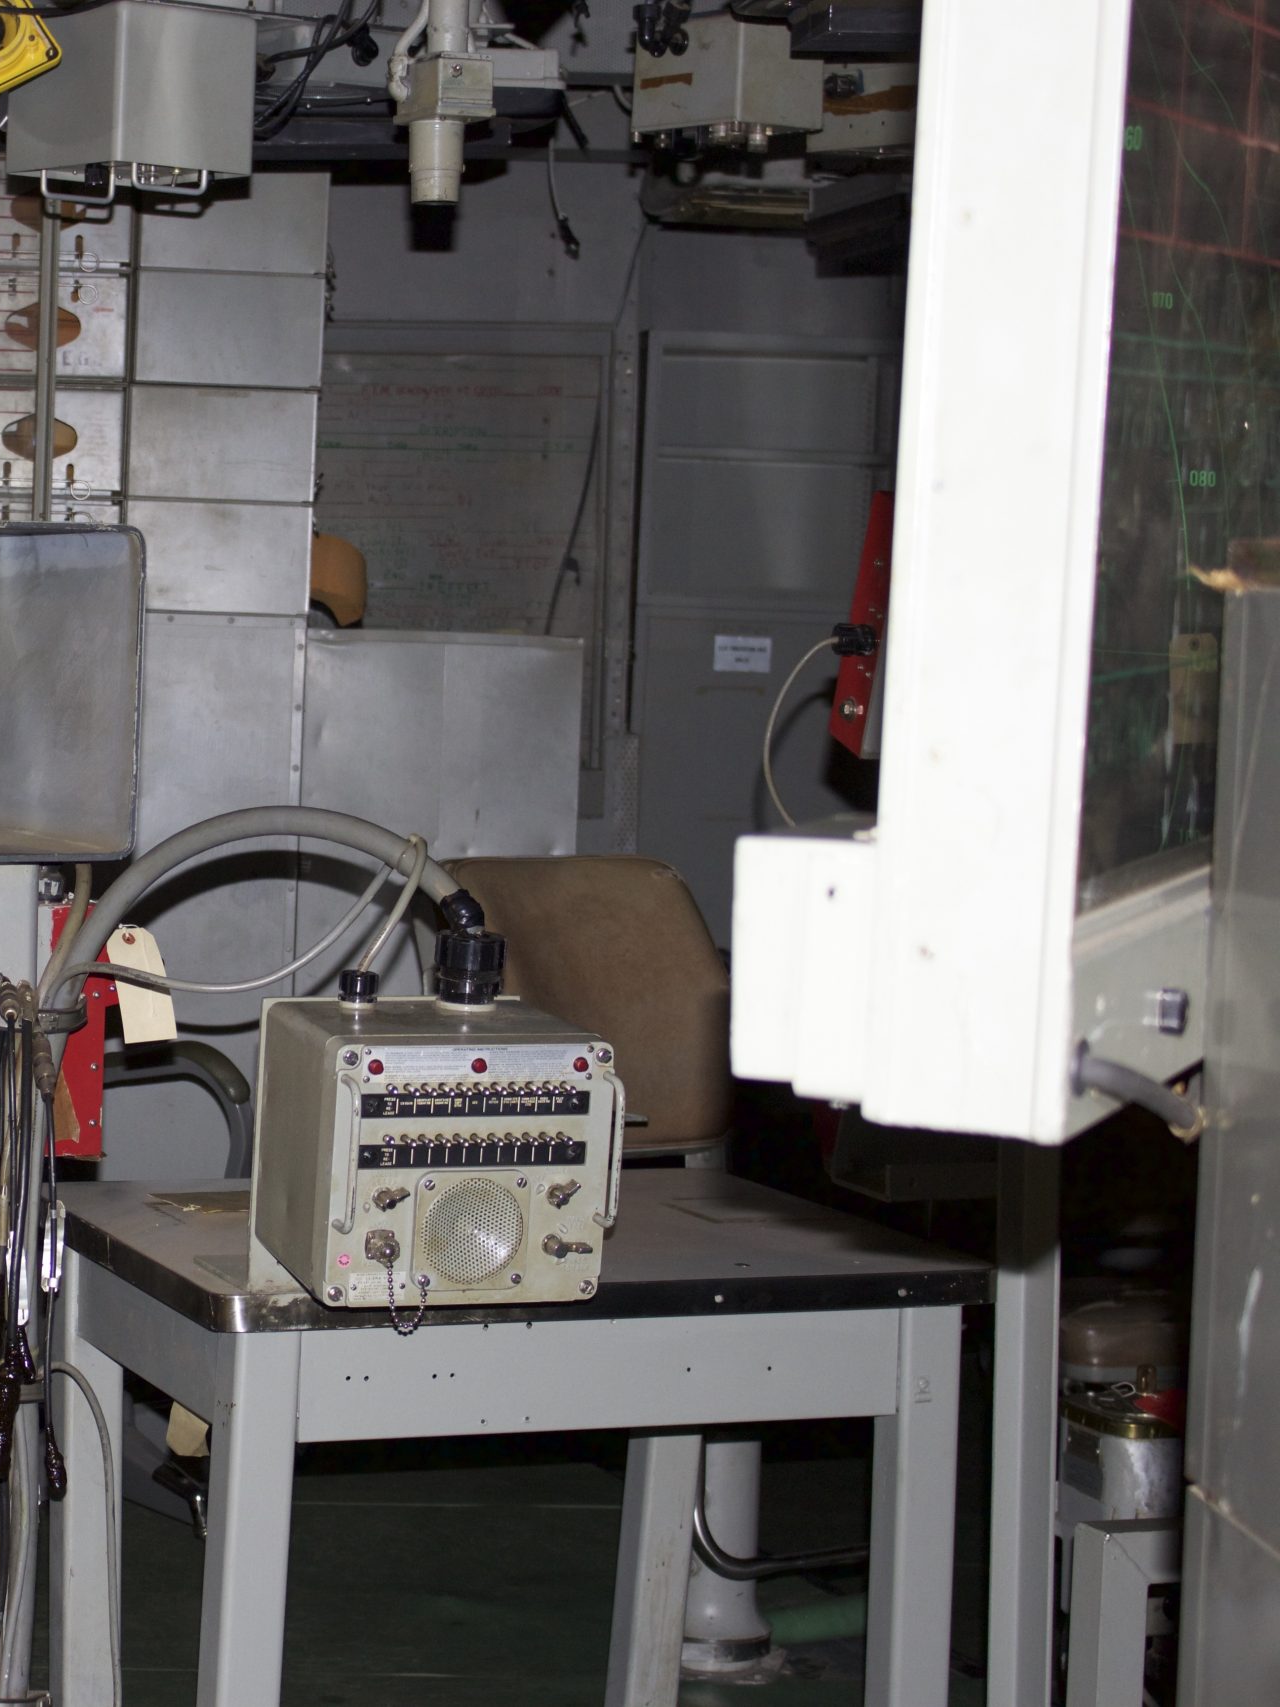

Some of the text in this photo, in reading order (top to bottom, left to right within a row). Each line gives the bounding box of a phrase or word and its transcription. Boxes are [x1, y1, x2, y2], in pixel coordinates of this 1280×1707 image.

[1124, 126, 1142, 151] 60
[1152, 291, 1174, 310] 070
[1189, 470, 1216, 488] 080
